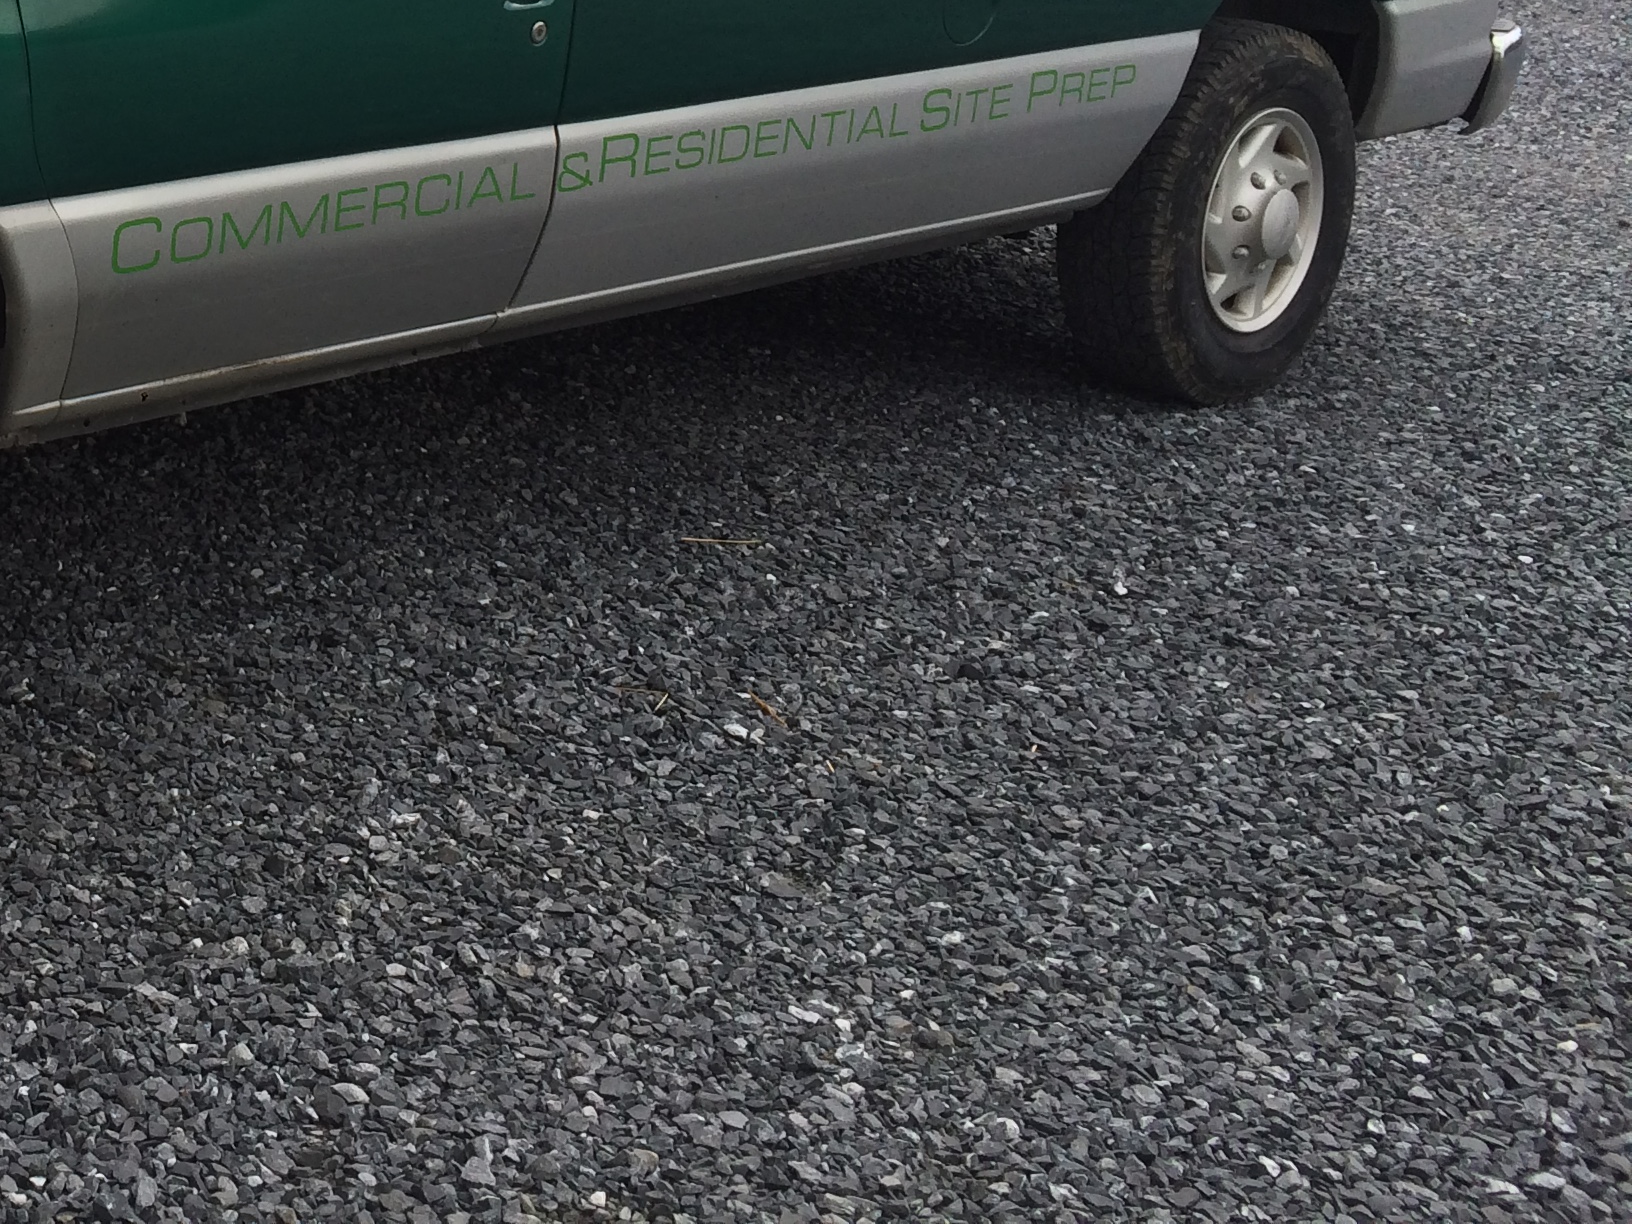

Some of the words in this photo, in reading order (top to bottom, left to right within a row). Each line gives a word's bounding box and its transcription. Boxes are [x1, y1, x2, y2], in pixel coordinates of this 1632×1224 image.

[111, 162, 536, 274] COMMERCIAL
[919, 82, 1014, 133] SITE
[1026, 64, 1137, 114] PREP
